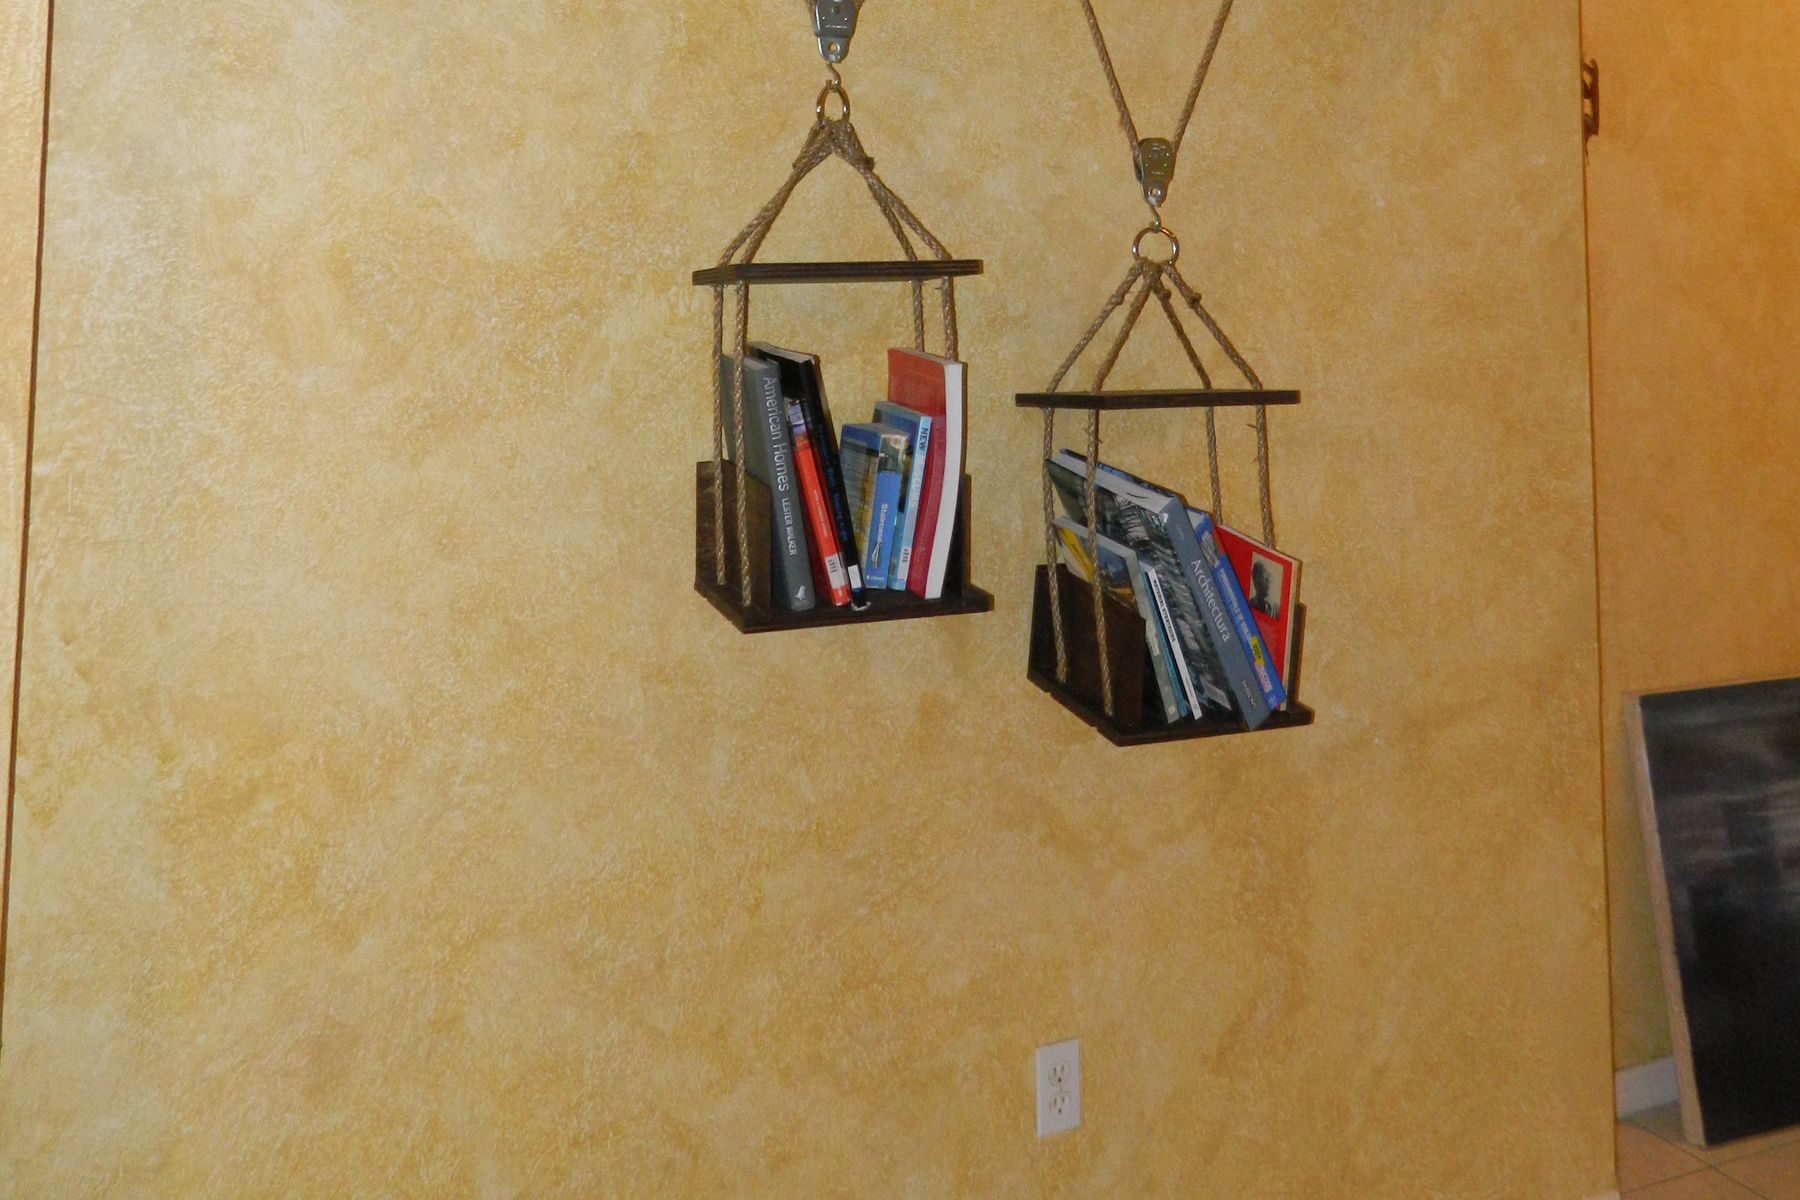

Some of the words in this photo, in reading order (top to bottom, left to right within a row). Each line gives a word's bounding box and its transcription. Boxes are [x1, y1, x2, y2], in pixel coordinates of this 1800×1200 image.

[763, 377, 784, 441] American
[919, 427, 929, 451] NEW
[772, 443, 791, 492] Homes
[781, 497, 794, 526] LESTER
[785, 525, 799, 556] WALKER
